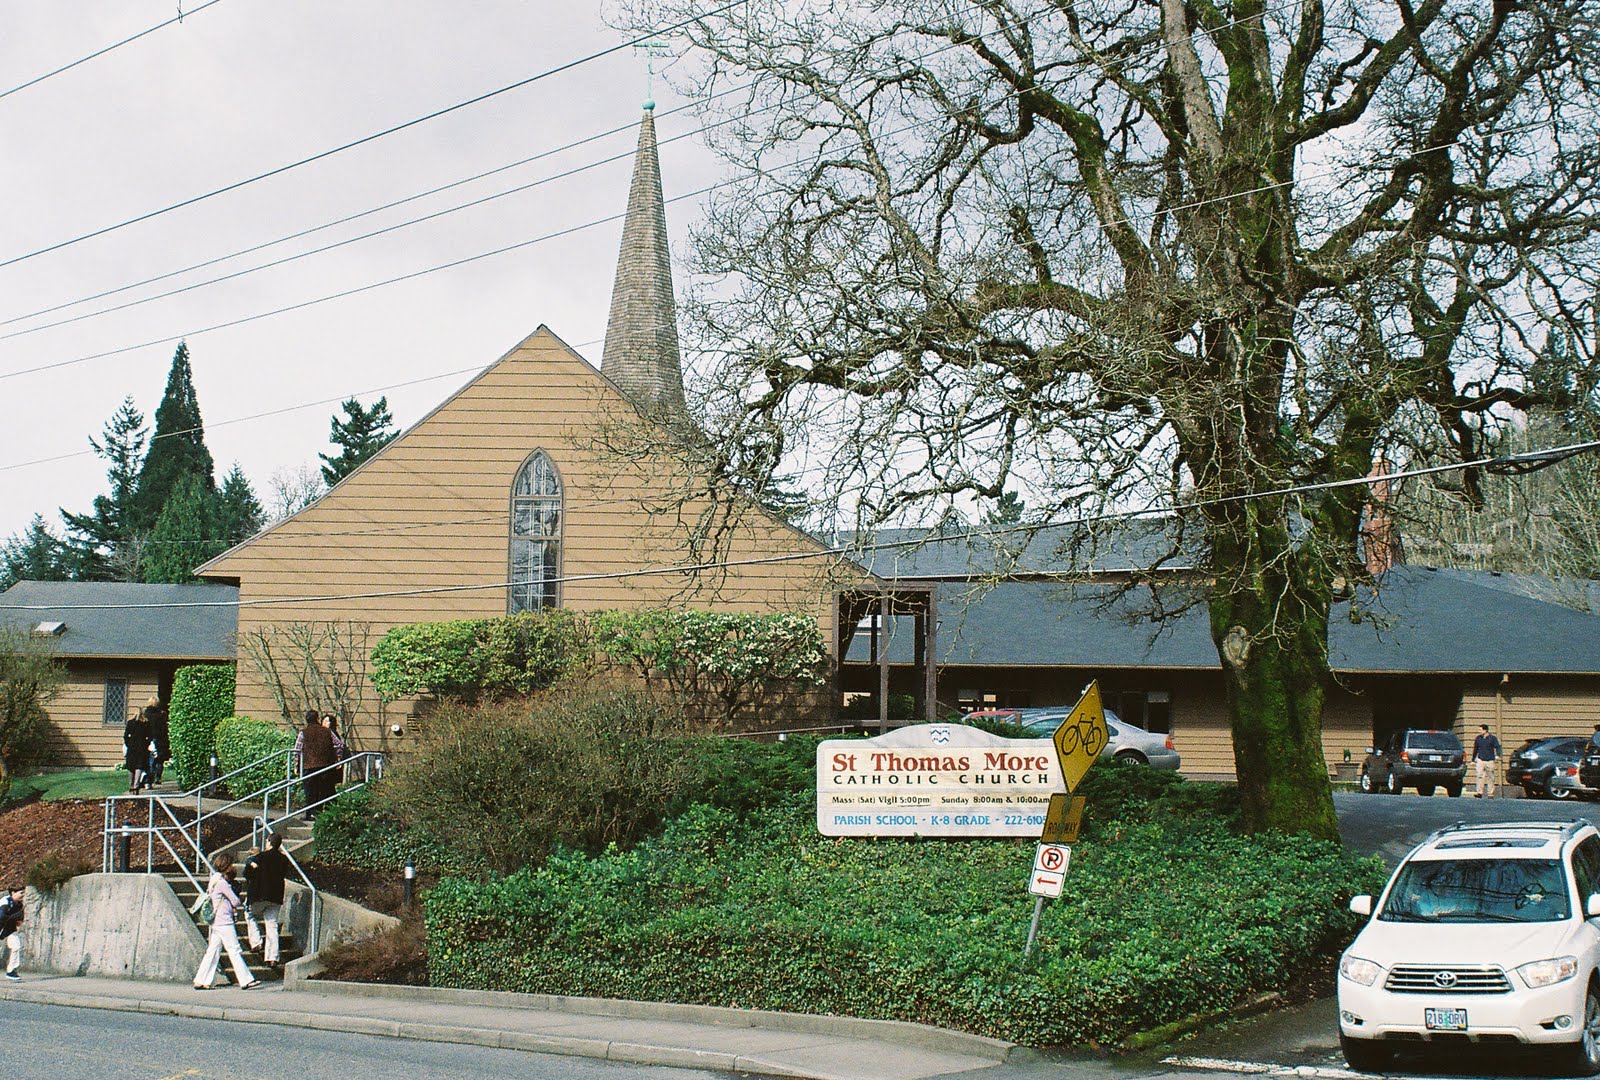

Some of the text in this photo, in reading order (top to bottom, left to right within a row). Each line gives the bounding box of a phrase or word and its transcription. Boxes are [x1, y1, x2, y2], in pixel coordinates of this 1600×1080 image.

[832, 752, 1049, 772] St Thomas More
[833, 773, 1049, 785] CATHOLIC CHURCH
[832, 796, 1050, 805] Mass: (Sat) Vigil 5:00pm Sunday 8:00am & 10:00am
[834, 815, 872, 825] PARISH
[876, 815, 918, 825] SCHOOL
[931, 815, 950, 825] K-8
[954, 815, 991, 825] GRADE
[1047, 822, 1078, 835] ROAWAY
